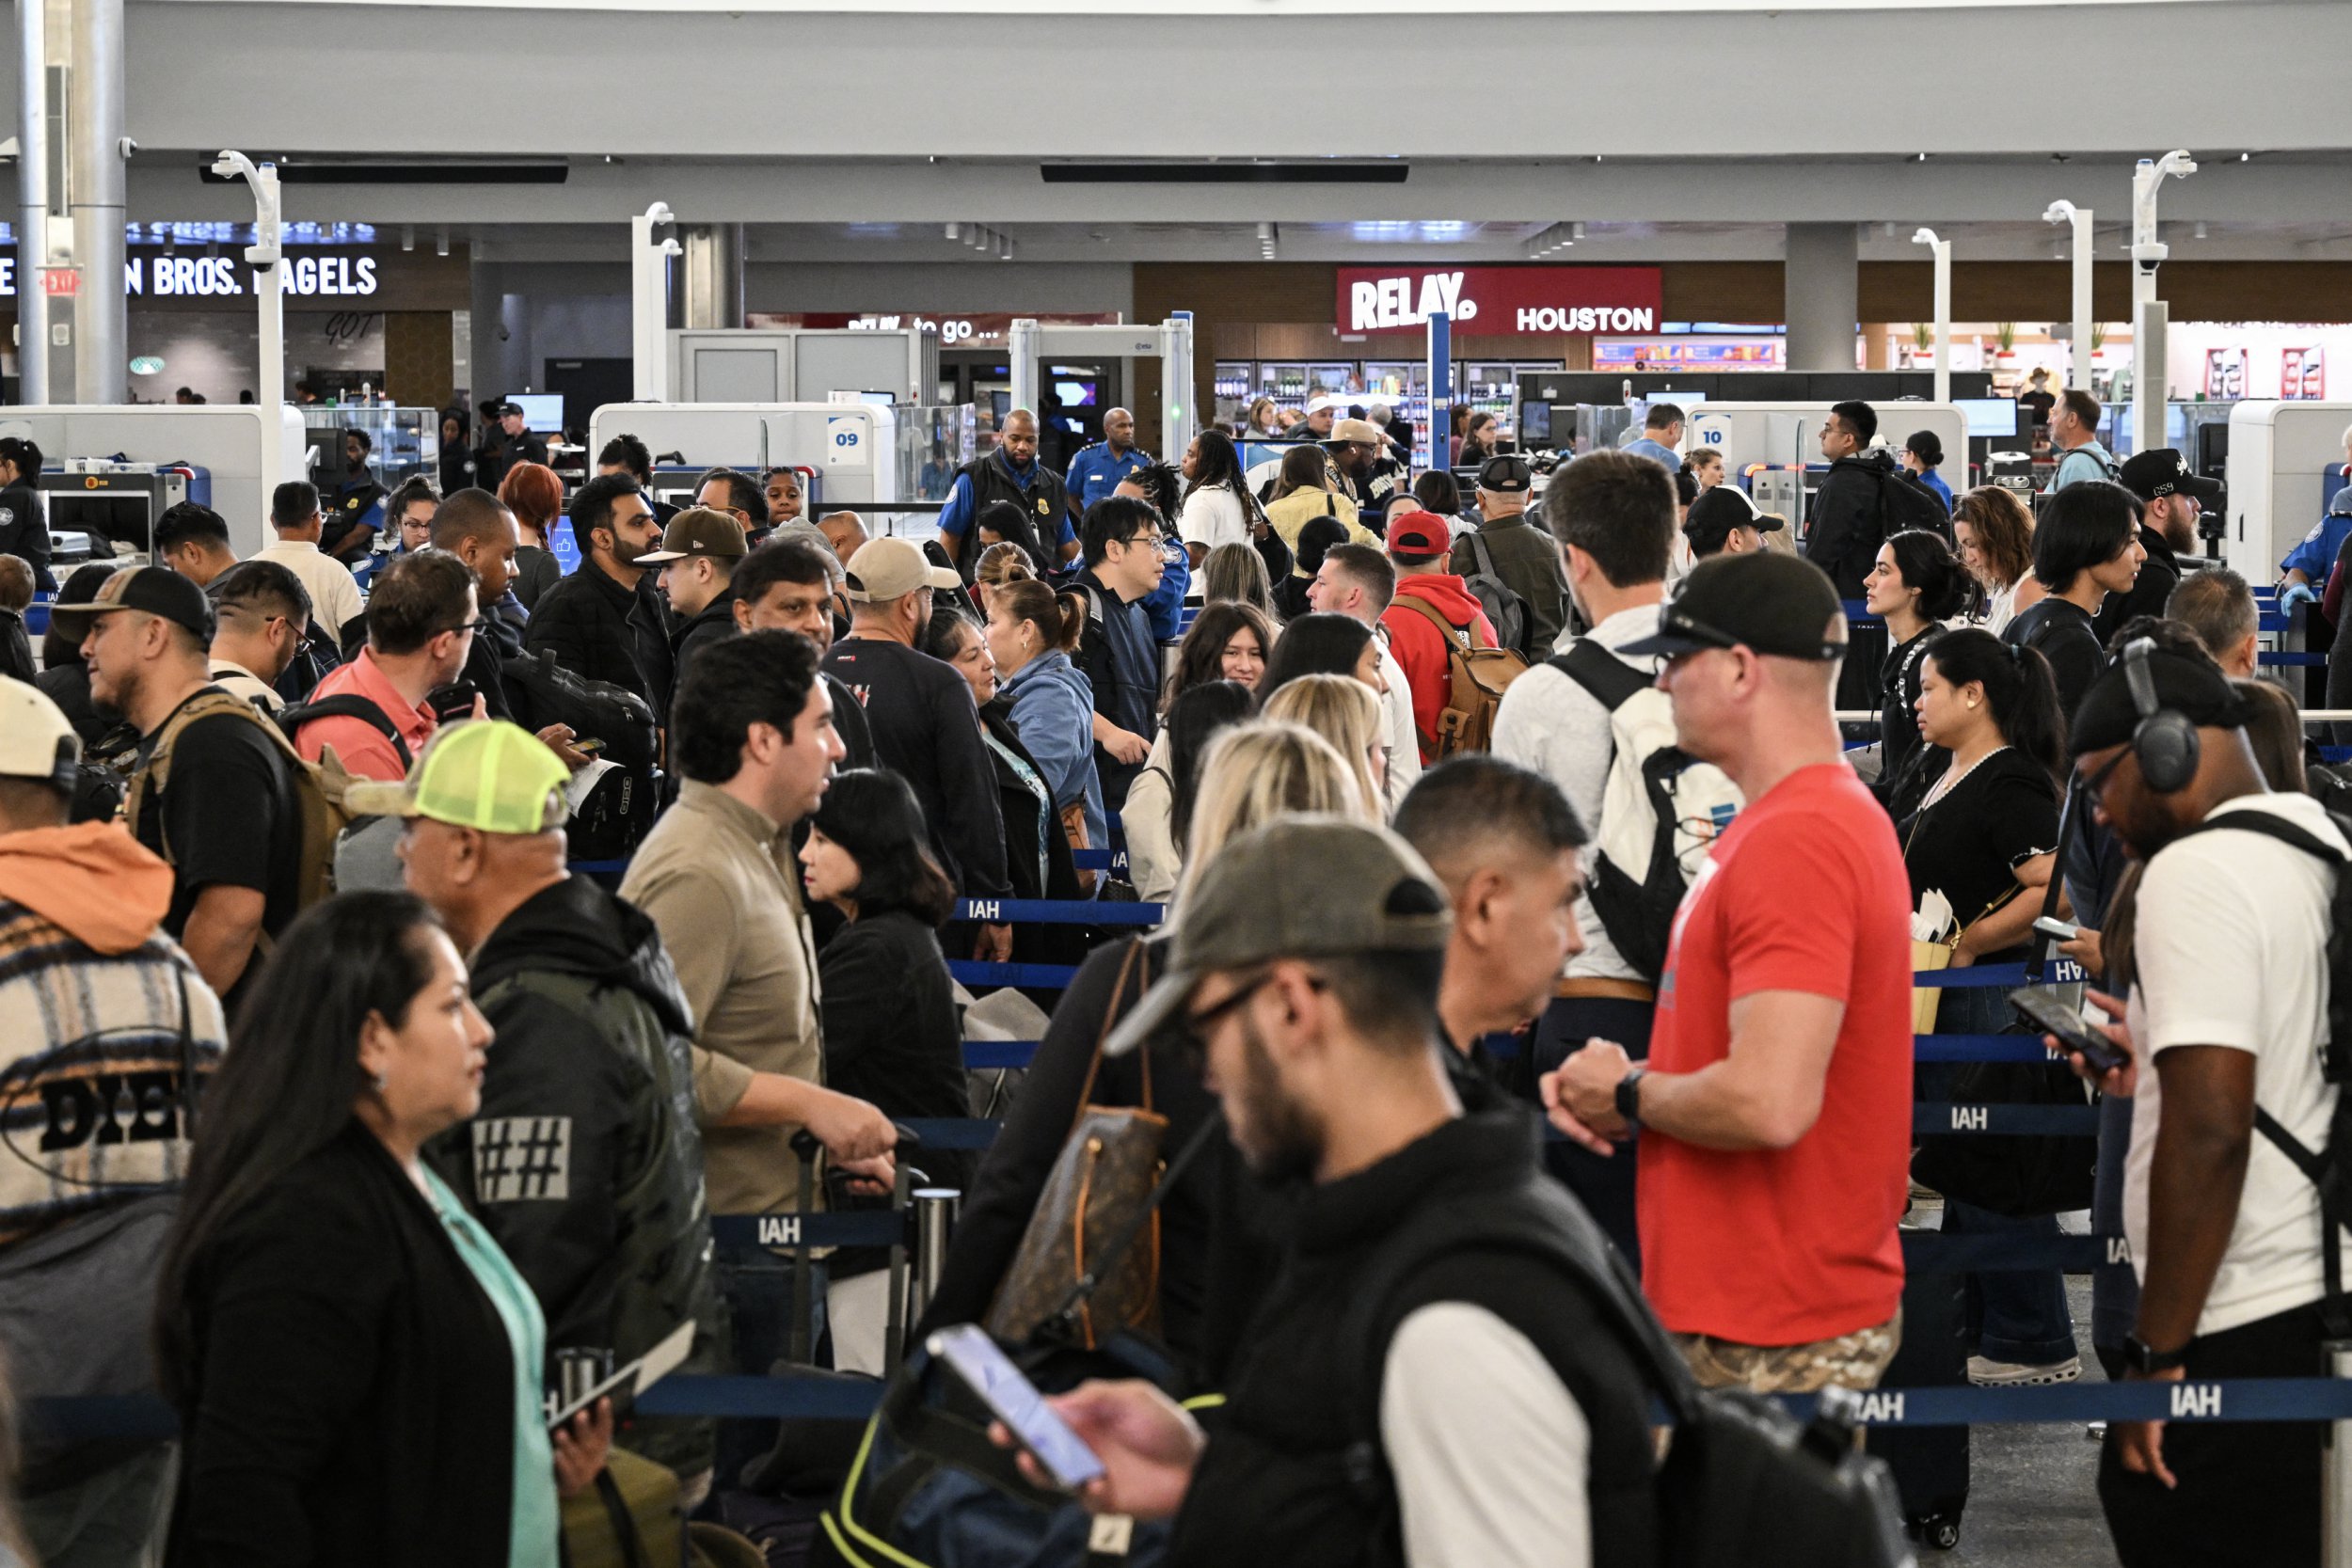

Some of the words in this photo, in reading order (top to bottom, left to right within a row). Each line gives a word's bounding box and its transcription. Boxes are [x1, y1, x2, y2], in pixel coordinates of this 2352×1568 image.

[153, 257, 242, 295] BROS.
[253, 257, 377, 295] AGELS
[1517, 308, 1653, 331] HOUSTON
[943, 321, 973, 343] go
[835, 433, 859, 447] 09
[1703, 431, 1723, 444] 10
[1112, 851, 1129, 868] IA
[969, 900, 1000, 919] IAH
[1951, 1106, 1988, 1130] IAH
[758, 1216, 801, 1244] IAH
[2106, 1237, 2132, 1264] IA
[2170, 1384, 2222, 1418] IAH
